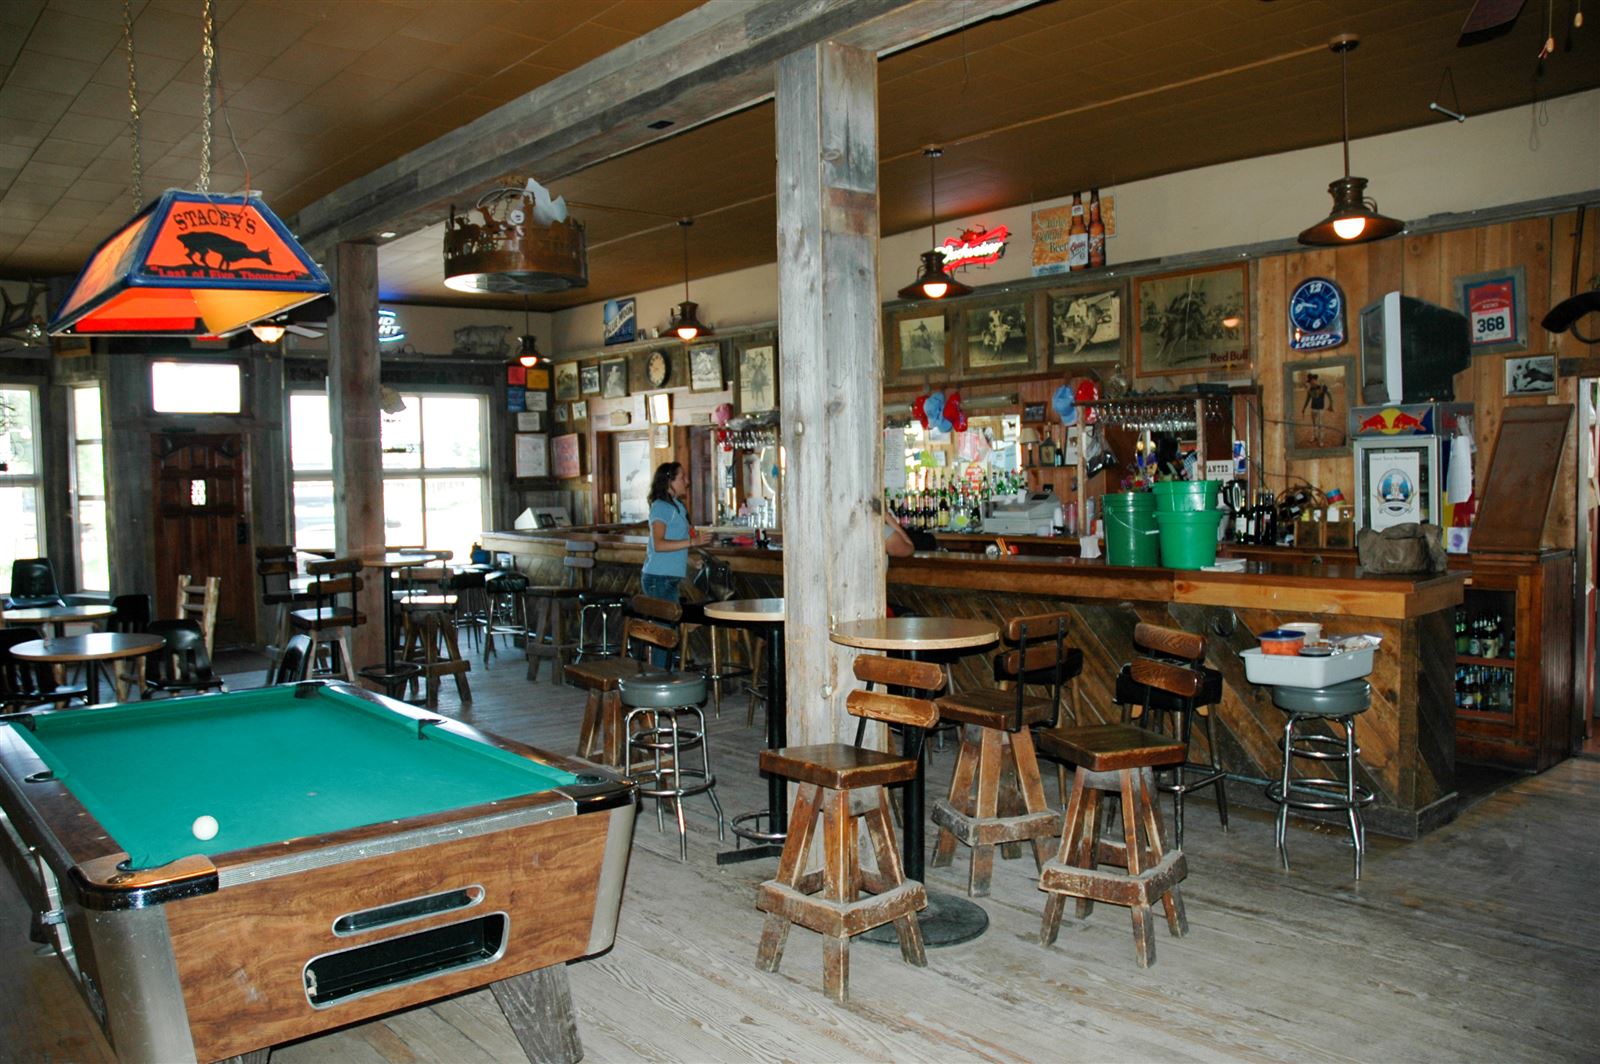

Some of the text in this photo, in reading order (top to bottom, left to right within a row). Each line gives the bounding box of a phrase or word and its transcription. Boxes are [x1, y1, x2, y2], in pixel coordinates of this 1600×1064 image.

[173, 208, 257, 235] STACEY'S
[1310, 282, 1322, 294] 12
[1295, 303, 1304, 314] 9
[1329, 298, 1337, 309] 3
[1312, 318, 1322, 329] 6
[1476, 315, 1505, 333] 368
[1295, 338, 1335, 349] LIGHT
[1301, 333, 1331, 343] BUD
[1210, 349, 1249, 363] Red Bull
[1207, 464, 1229, 473] ANTED
